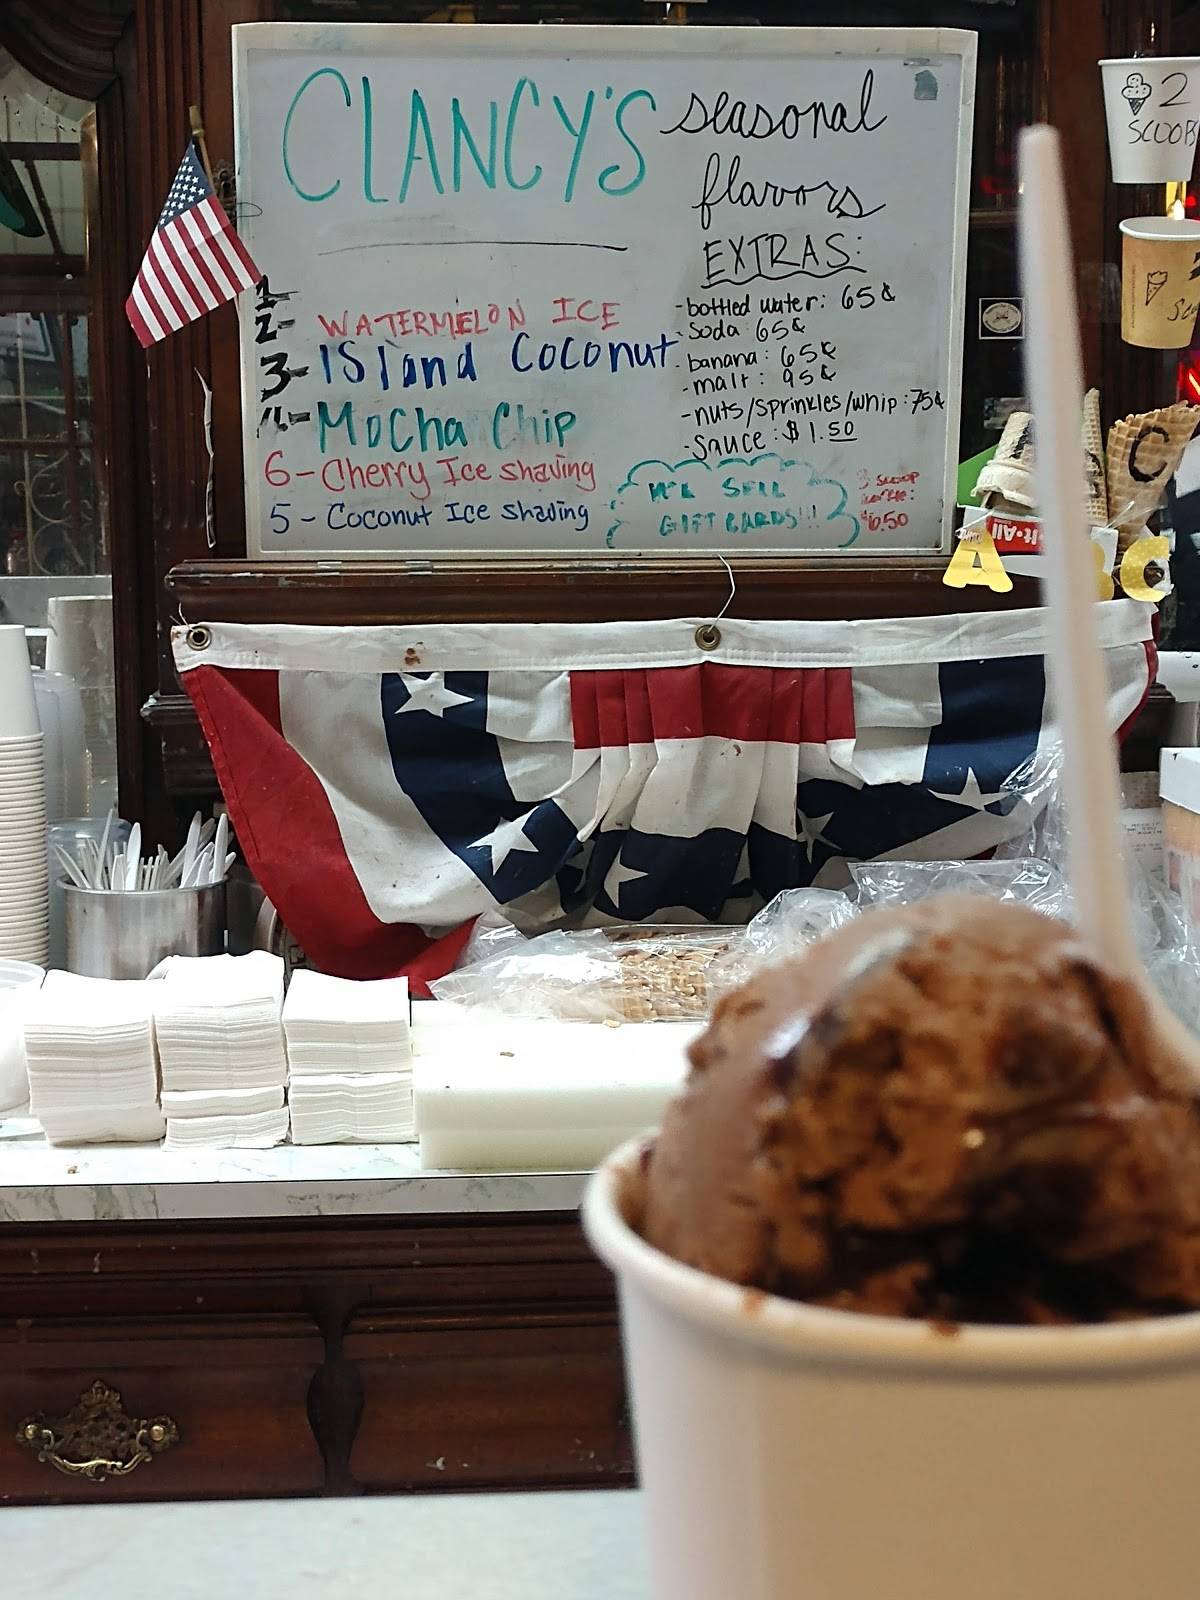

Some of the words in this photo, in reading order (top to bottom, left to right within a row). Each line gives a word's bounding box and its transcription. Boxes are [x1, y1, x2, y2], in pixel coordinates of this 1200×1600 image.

[660, 69, 887, 139] seasonal
[1159, 72, 1192, 108] 2
[282, 67, 656, 203] CLANCY'S
[691, 152, 886, 230] flavors
[702, 233, 862, 281] EXTRAS:
[318, 299, 525, 340] WATERMELON
[552, 297, 621, 331] ICE
[760, 292, 826, 314] water:
[493, 402, 577, 450] Chip
[1128, 426, 1169, 482] C
[322, 458, 431, 501] Cherry
[436, 456, 492, 487] Ice
[327, 502, 433, 530] Coconut
[444, 502, 491, 523] Ice
[659, 511, 716, 537] GIFT
